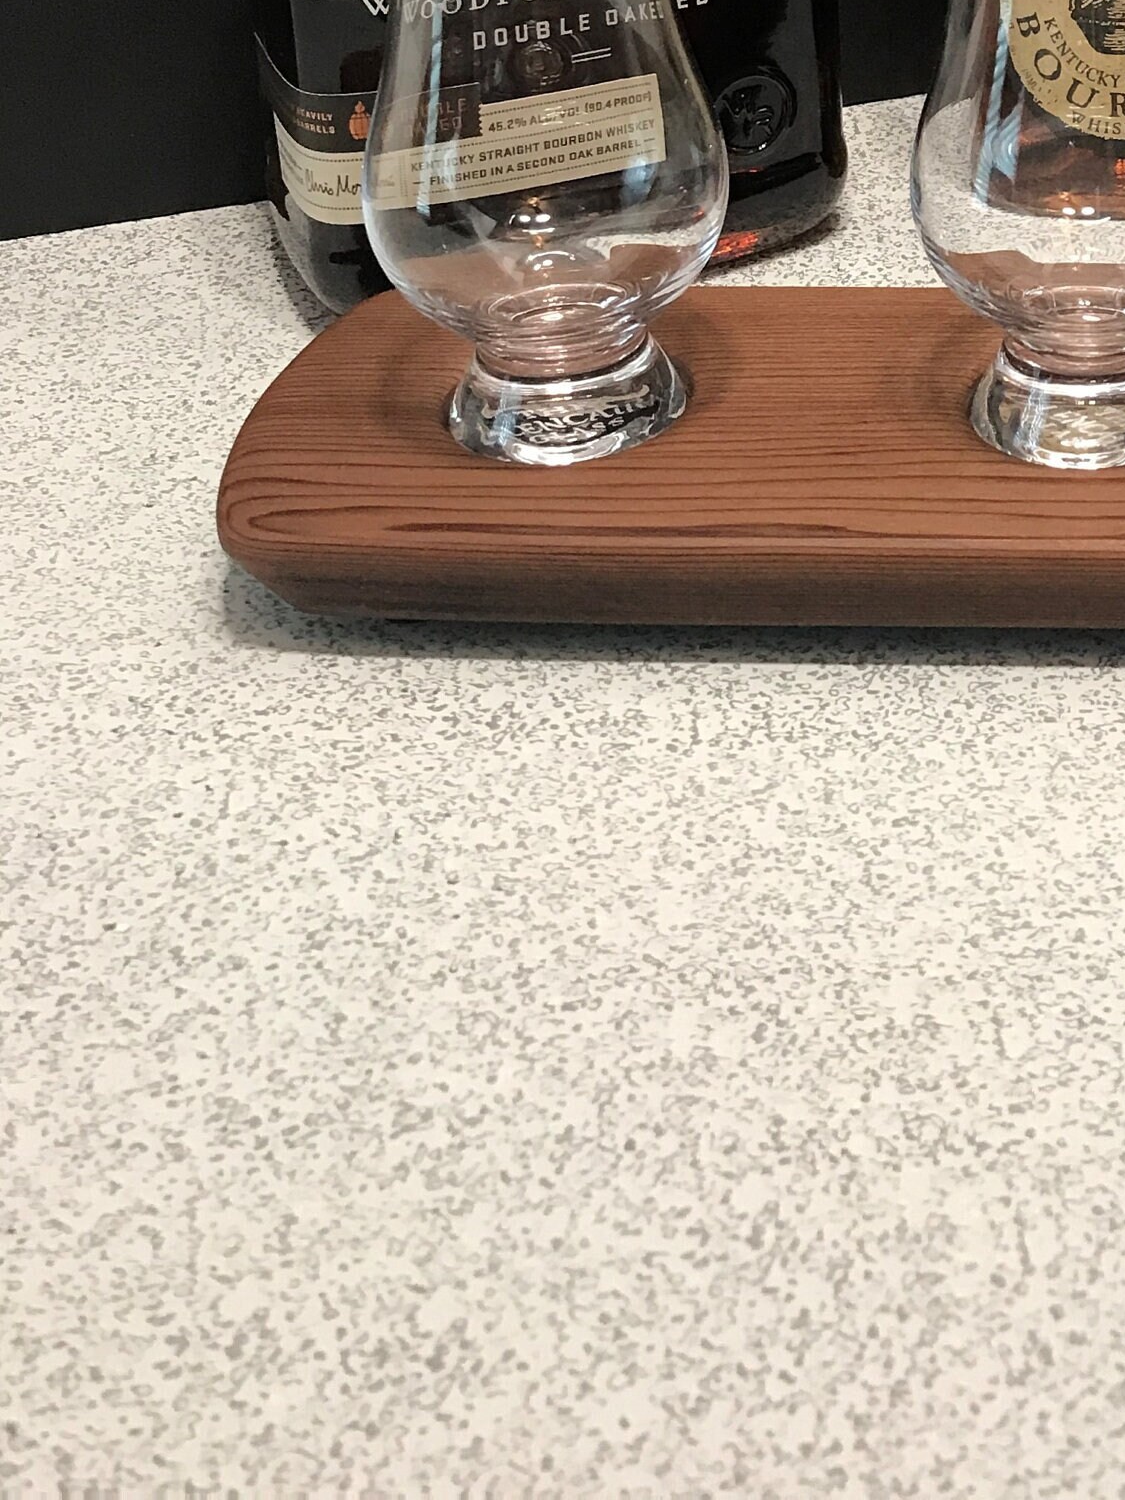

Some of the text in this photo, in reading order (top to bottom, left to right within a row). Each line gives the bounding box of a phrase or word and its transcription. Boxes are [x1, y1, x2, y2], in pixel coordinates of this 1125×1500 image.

[473, 13, 592, 50] DOUBLE
[1044, 17, 1120, 88] KENTUCKY
[410, 118, 656, 173] KENTUCKY STRAIGHT BOURBON WHISKEY
[488, 117, 527, 133] 45.2%
[429, 138, 642, 186] FINISHED IN A SECOND OAK BARREL
